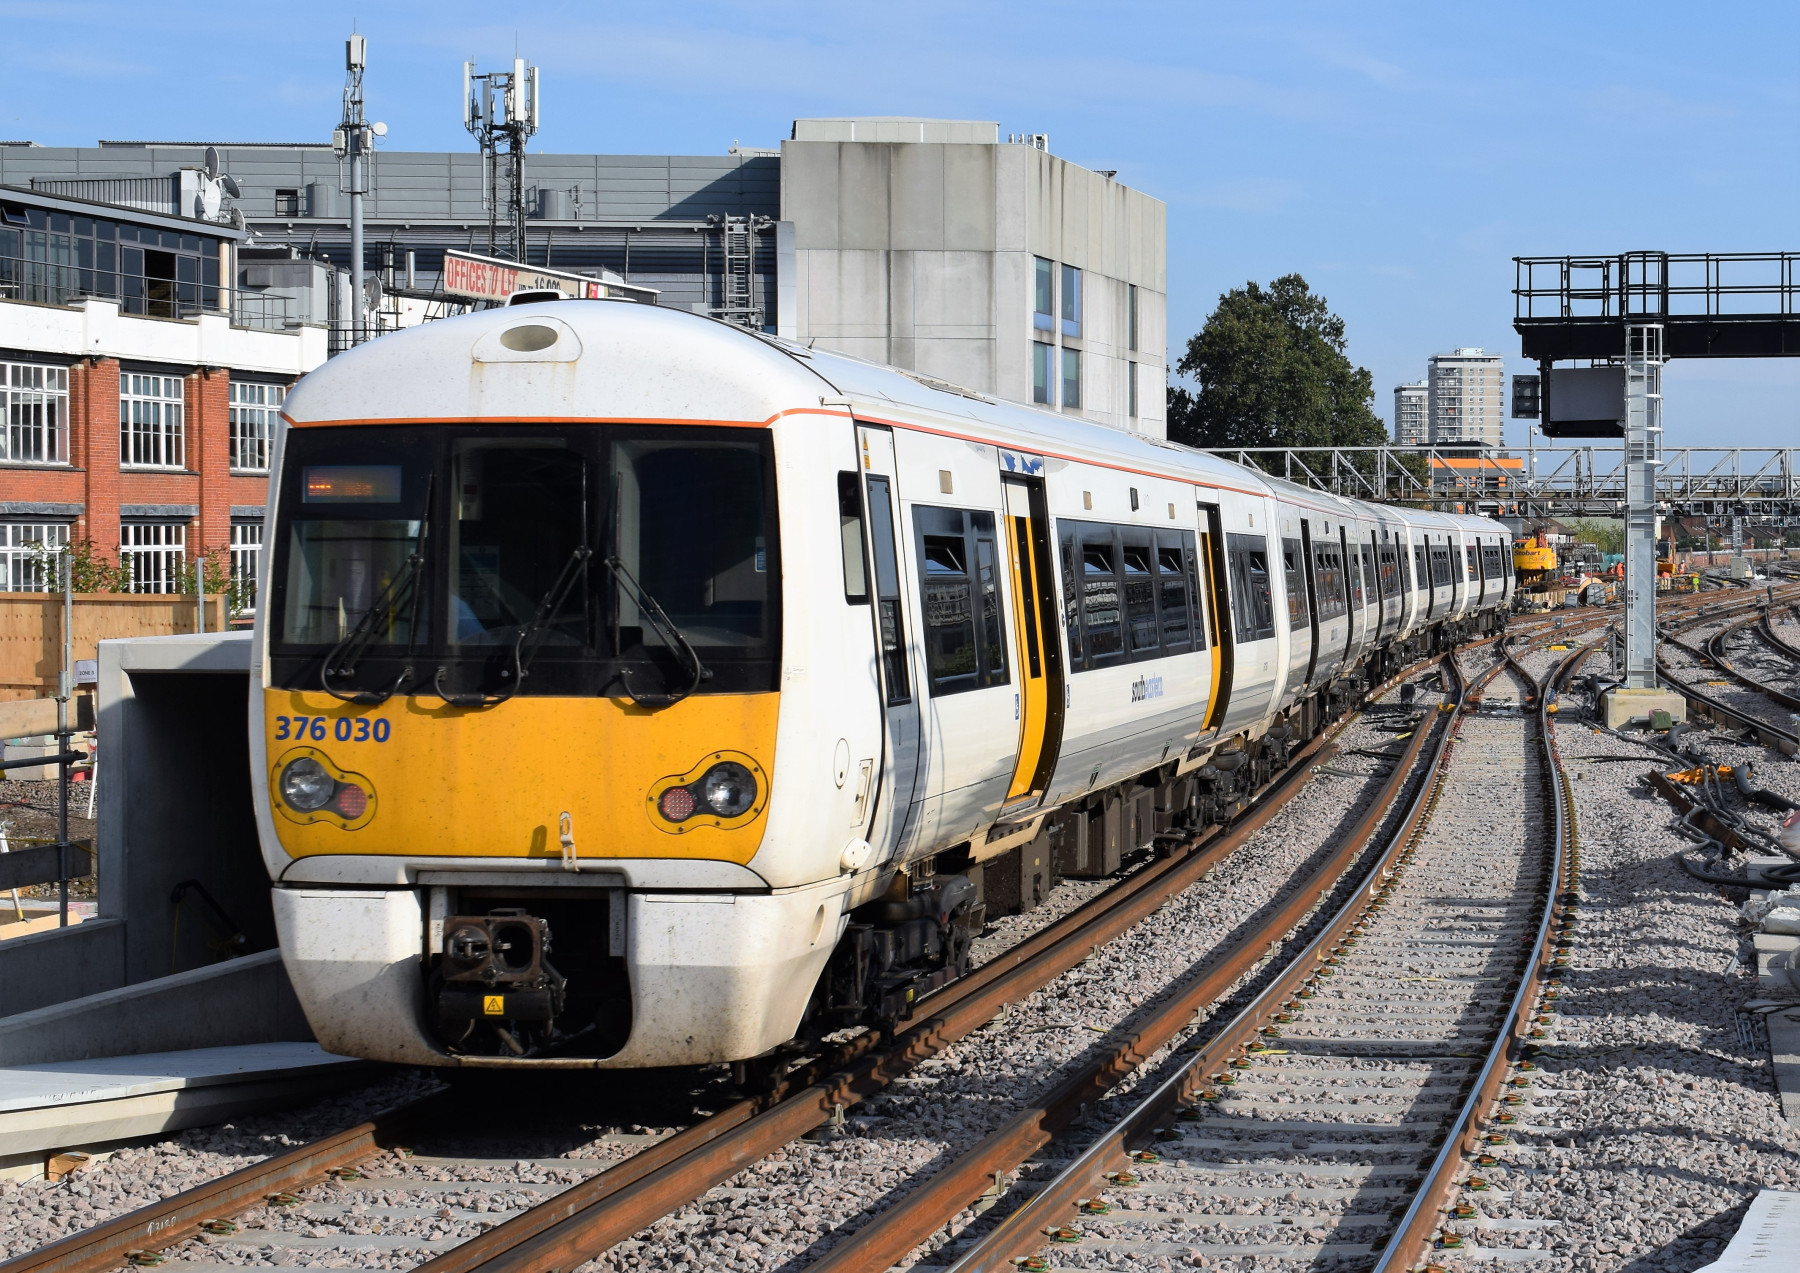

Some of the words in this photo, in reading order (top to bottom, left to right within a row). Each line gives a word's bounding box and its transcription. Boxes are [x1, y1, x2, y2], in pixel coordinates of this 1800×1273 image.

[447, 258, 487, 294] OFFICES
[488, 265, 499, 295] TO
[501, 268, 518, 296] LET
[534, 276, 561, 290] 16000
[1131, 672, 1163, 703] southeastern
[275, 715, 326, 741] 376
[334, 717, 391, 742] 030
